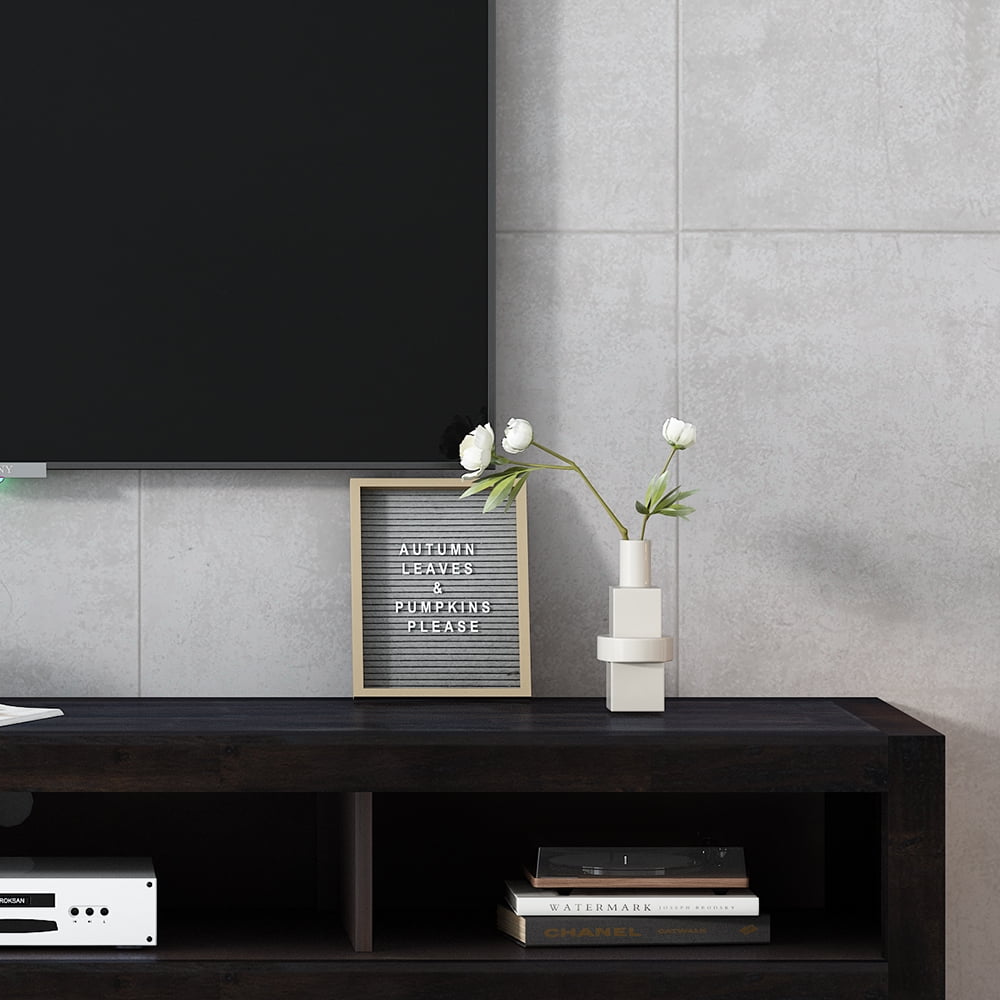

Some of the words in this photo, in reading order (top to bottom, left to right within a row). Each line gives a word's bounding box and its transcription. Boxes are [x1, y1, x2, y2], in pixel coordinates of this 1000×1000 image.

[399, 543, 474, 556] AUTUMN
[402, 562, 473, 575] LEAVES
[433, 581, 442, 594] &
[395, 601, 490, 613] PUMPKINS
[407, 620, 479, 633] PLEASE
[549, 903, 652, 912] WATERMARK
[543, 927, 642, 938] CHANEL
